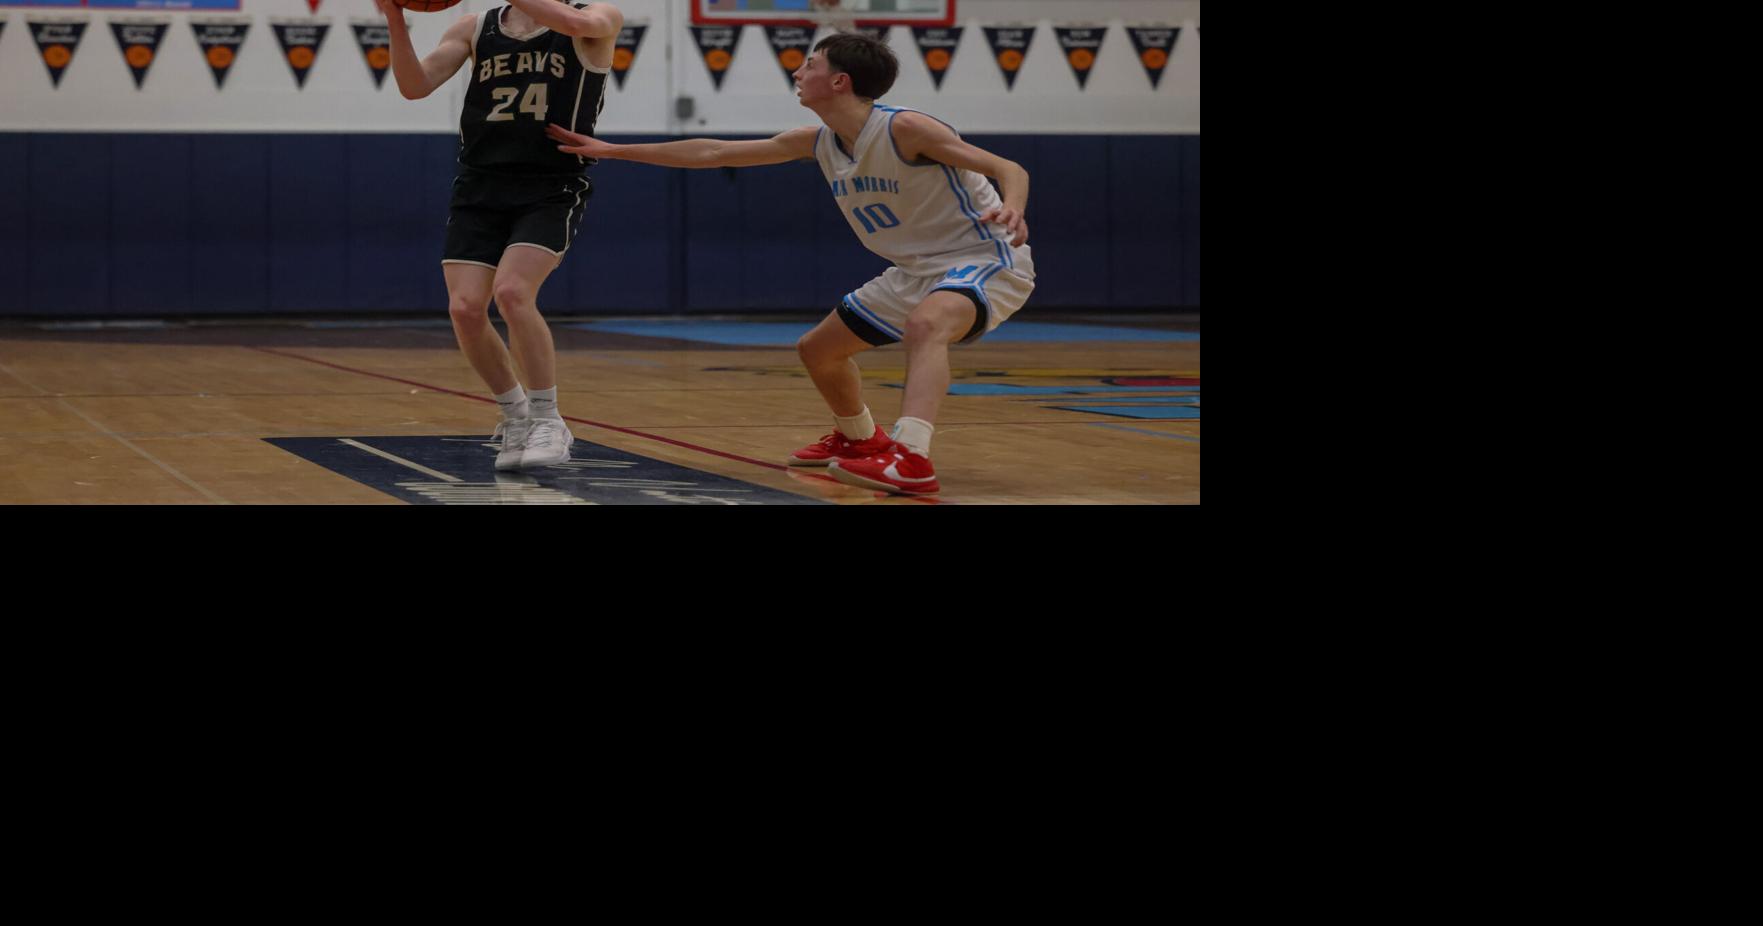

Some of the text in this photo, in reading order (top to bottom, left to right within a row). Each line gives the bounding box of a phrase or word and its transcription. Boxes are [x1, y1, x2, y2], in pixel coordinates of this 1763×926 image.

[480, 51, 566, 82] BEAVS
[486, 83, 549, 121] 24
[852, 202, 901, 234] 10
